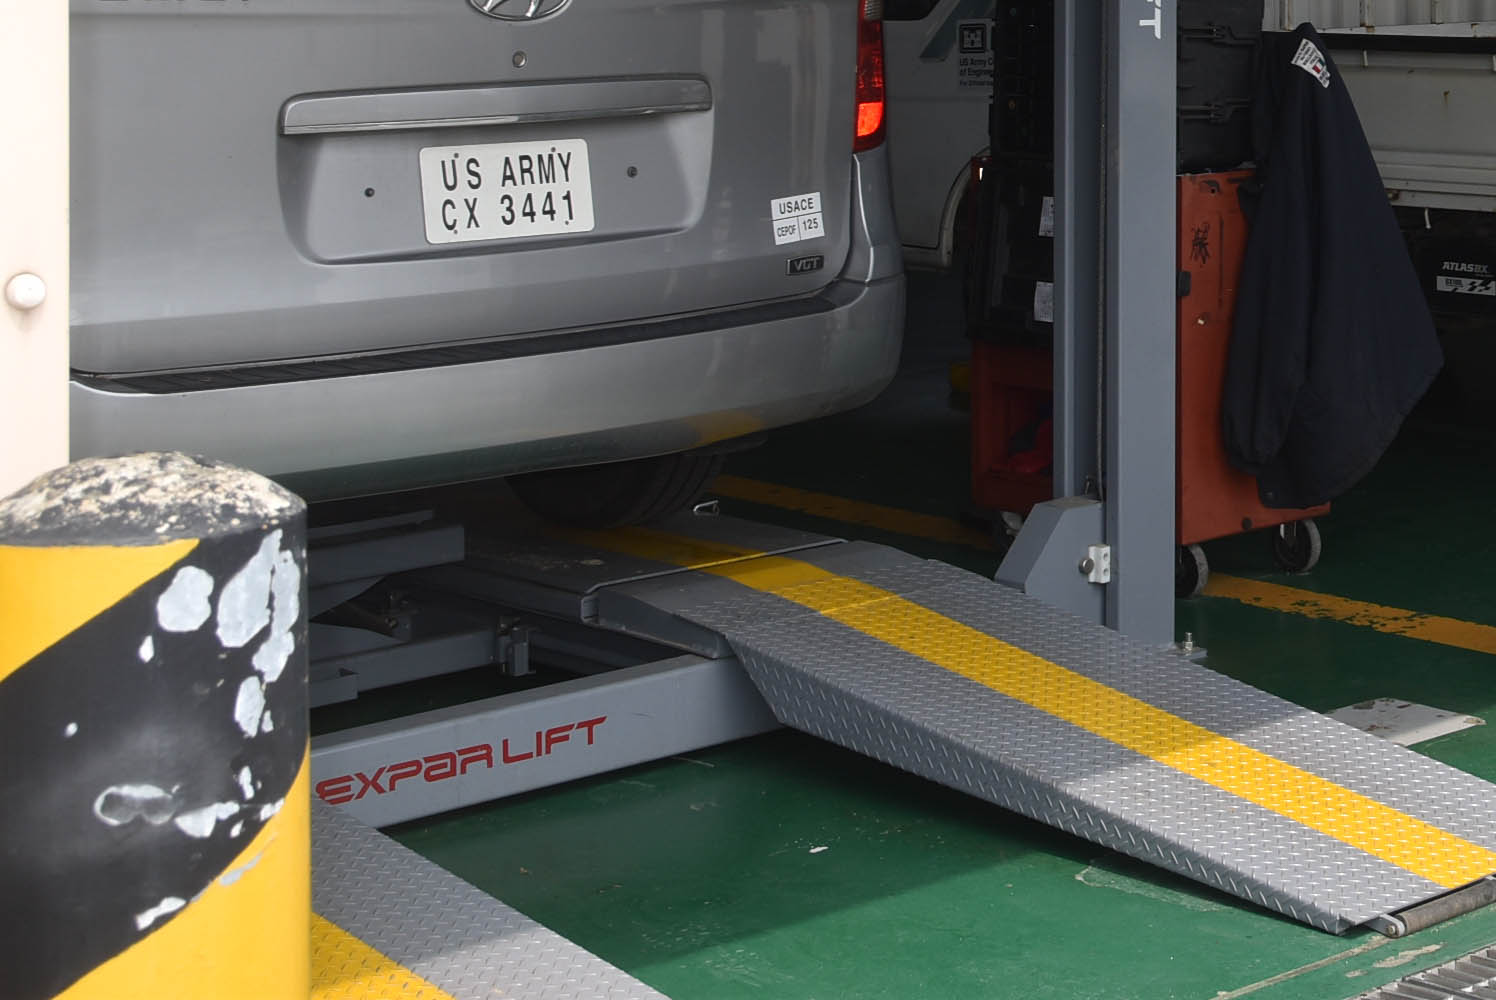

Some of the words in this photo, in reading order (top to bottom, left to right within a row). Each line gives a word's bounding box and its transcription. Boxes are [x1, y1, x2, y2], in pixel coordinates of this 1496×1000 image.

[441, 157, 483, 192] US
[501, 151, 572, 188] ARMY
[441, 197, 481, 232] CX
[500, 190, 574, 226] 3441
[779, 197, 815, 215] USACE
[802, 217, 819, 232] 125
[794, 258, 819, 271] VGT
[502, 715, 608, 764] LIFT
